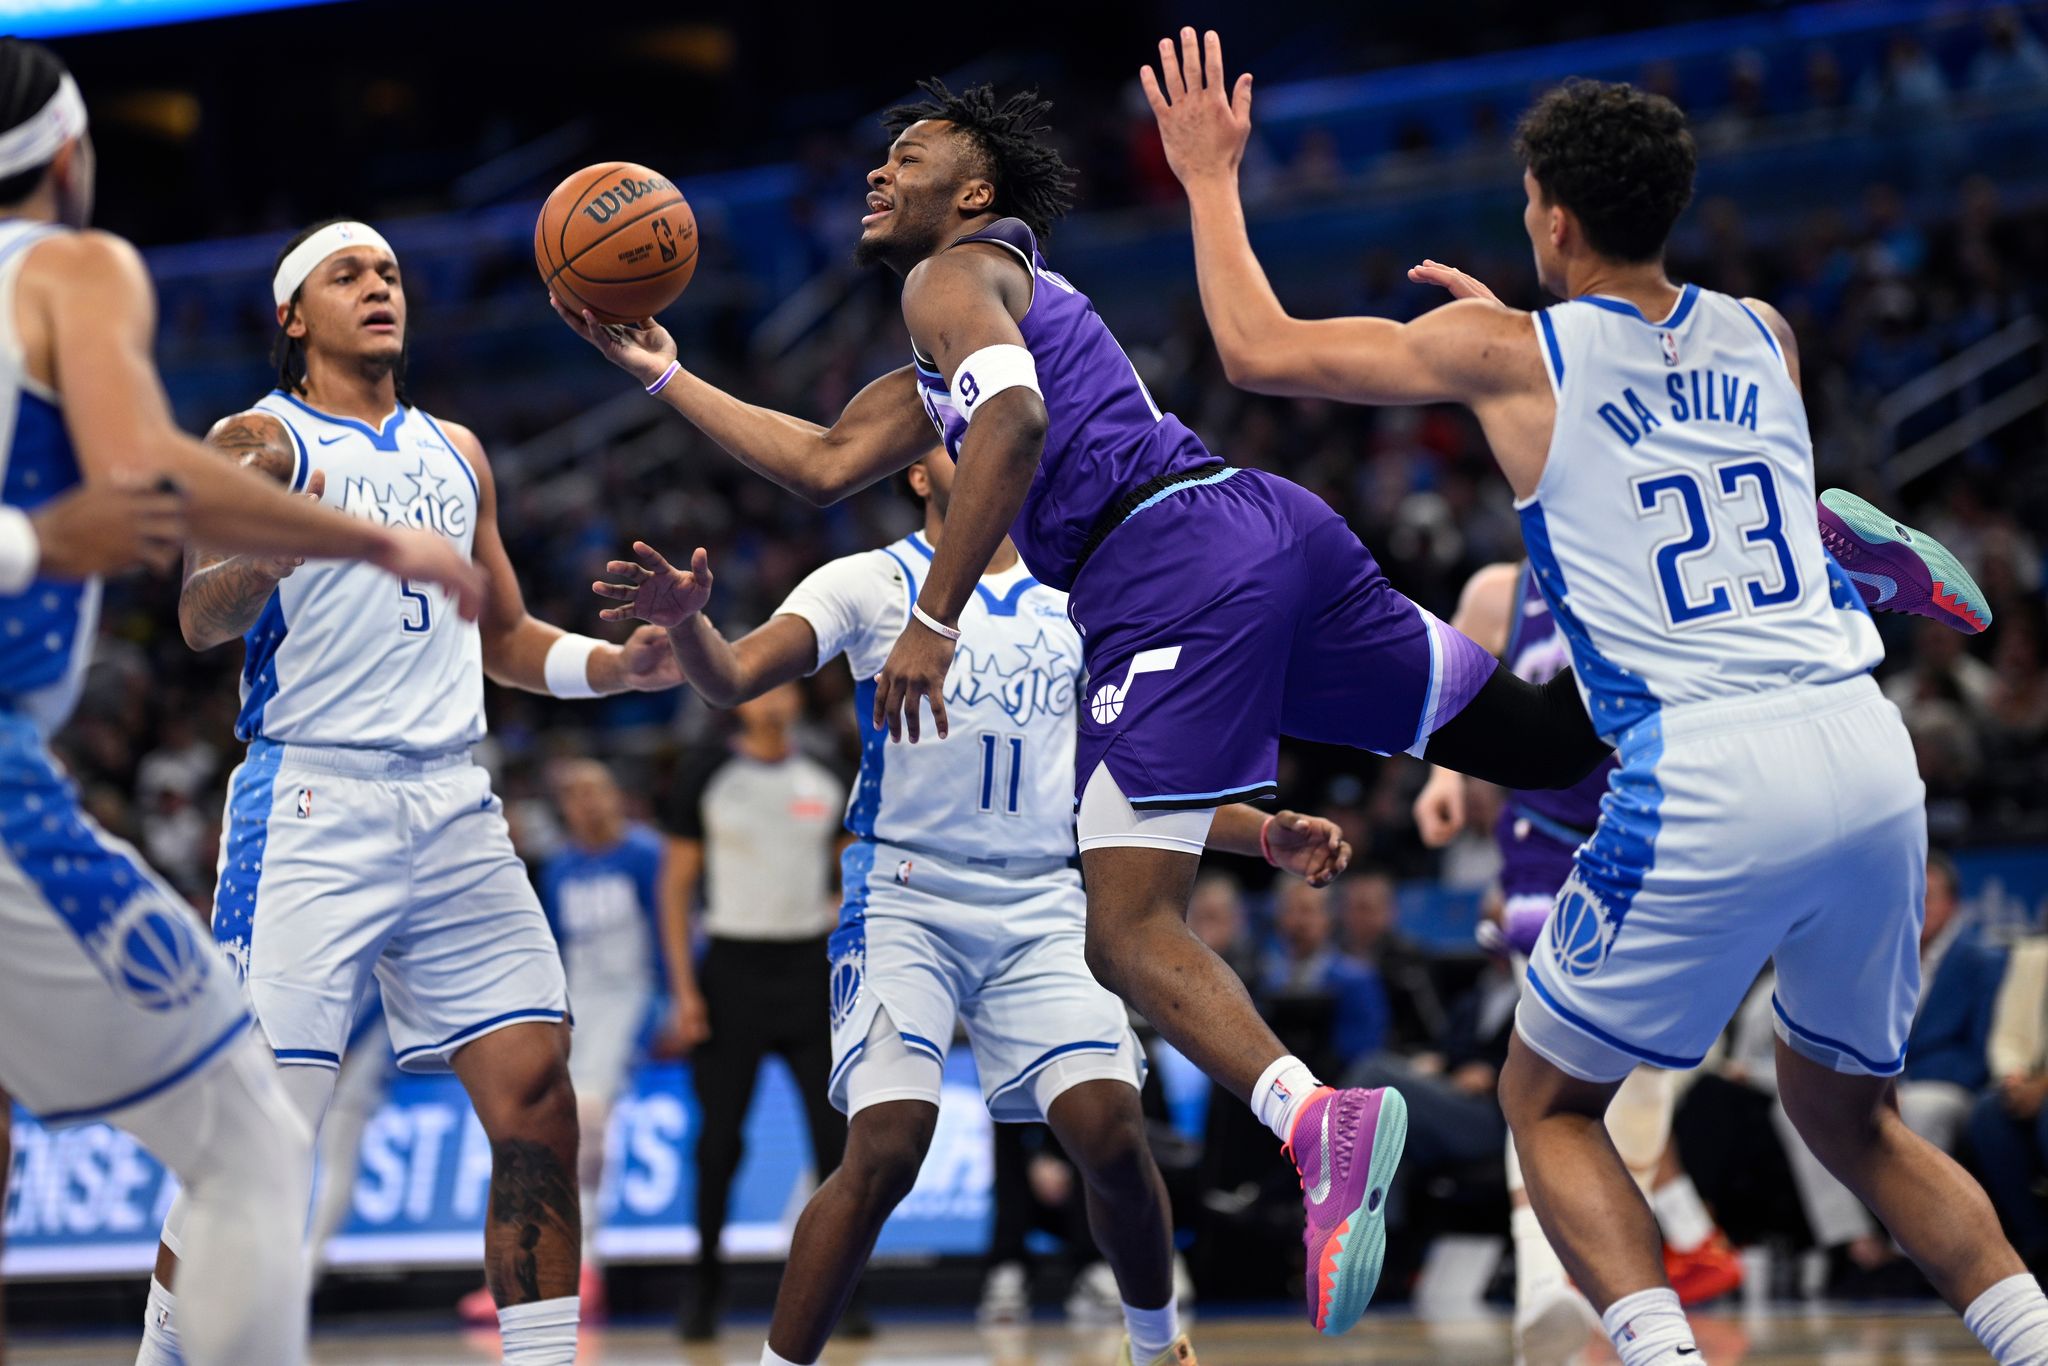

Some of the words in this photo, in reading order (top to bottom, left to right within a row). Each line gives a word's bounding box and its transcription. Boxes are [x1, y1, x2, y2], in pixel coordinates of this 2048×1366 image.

[583, 178, 681, 224] Wilson
[1597, 387, 1663, 448] DA
[1665, 369, 1760, 433] SILVA
[1629, 452, 1806, 634] 23
[400, 577, 435, 637] 5
[976, 730, 1025, 817] 11
